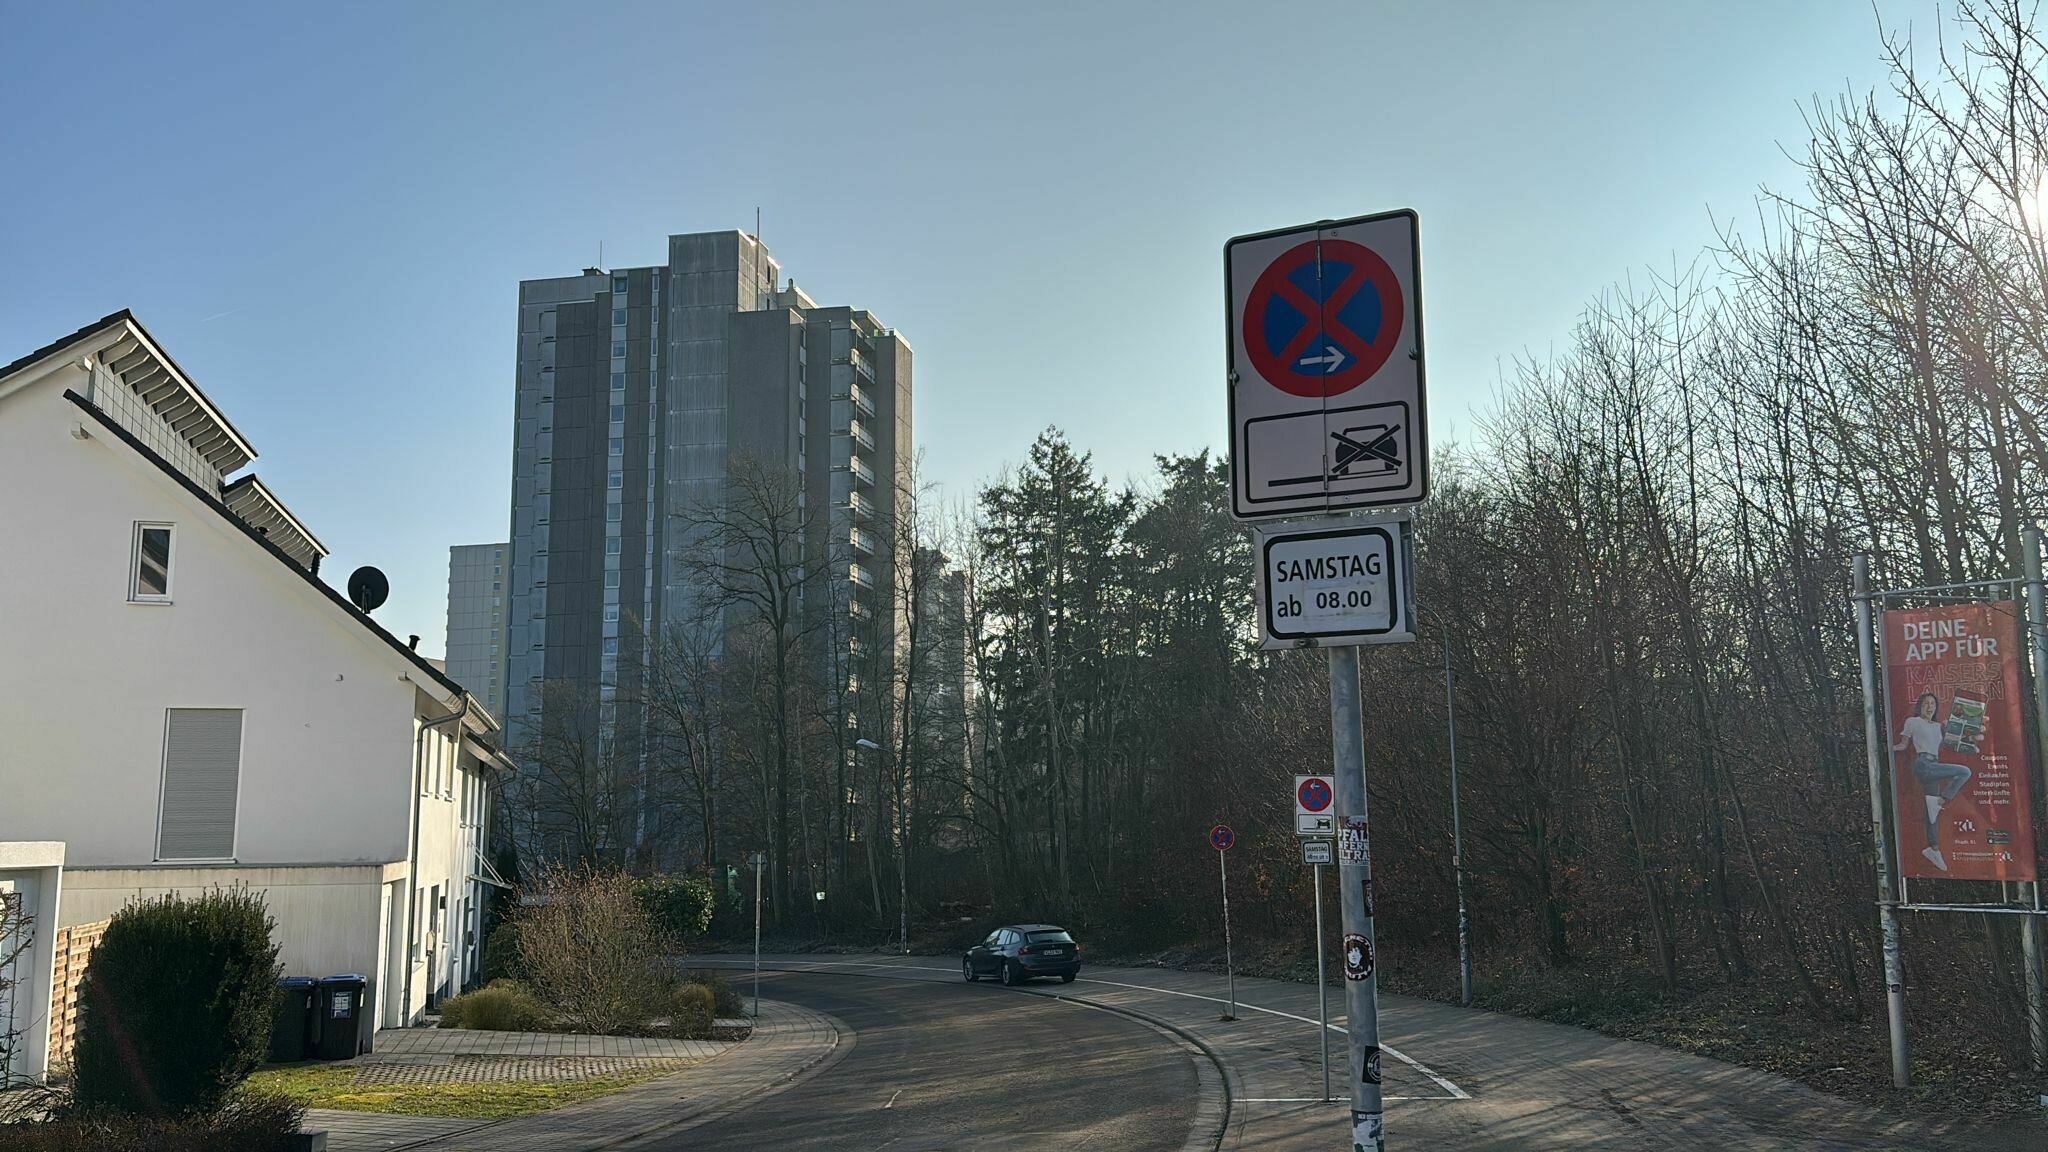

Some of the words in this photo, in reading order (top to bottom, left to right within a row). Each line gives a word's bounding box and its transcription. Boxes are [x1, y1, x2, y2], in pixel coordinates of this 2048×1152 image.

[1276, 553, 1381, 582] SAMSTAG
[1277, 594, 1303, 618] ab
[1316, 590, 1372, 609] 08.00
[1903, 618, 1967, 641] DEINE
[1905, 641, 1949, 661] APP
[1955, 634, 1999, 658] FÜR
[1905, 661, 2002, 684] KAISERS
[1907, 680, 2005, 704] LAUTN
[1337, 828, 1370, 842] PFAL
